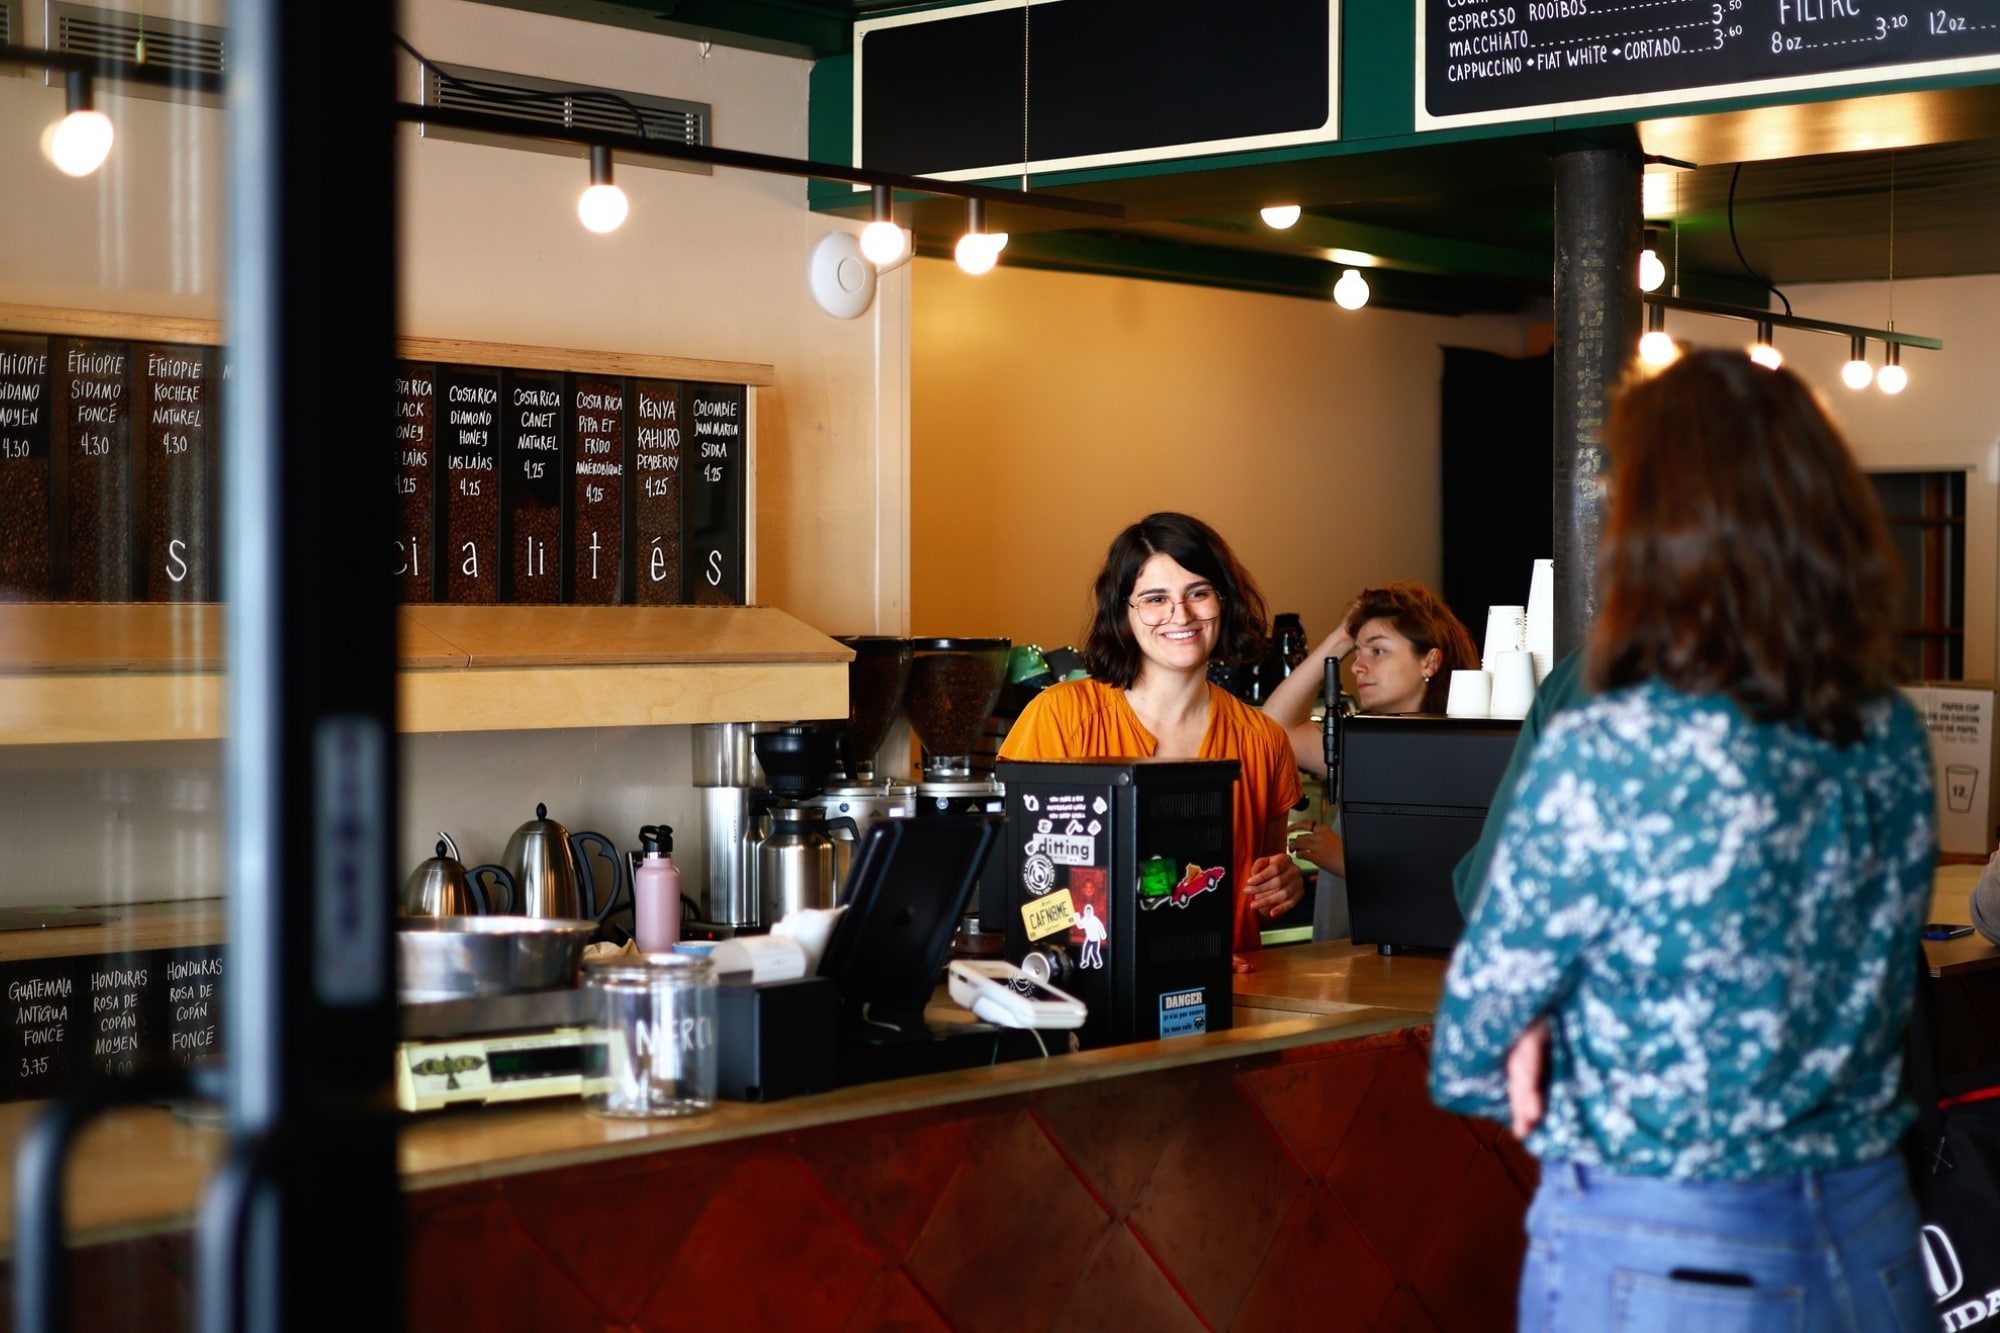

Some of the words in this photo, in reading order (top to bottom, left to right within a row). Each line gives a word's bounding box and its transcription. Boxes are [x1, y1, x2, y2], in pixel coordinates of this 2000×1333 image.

[1624, 36, 1681, 61] CORTADO
[154, 383, 200, 403] KOCHERE
[78, 403, 117, 423] FONCÉ
[640, 393, 676, 420] KENYA
[153, 407, 201, 427] NATUREL
[521, 412, 556, 428] CANET
[601, 419, 616, 432] ET
[3, 438, 30, 458] 4.30
[81, 432, 109, 455] 4.30
[163, 432, 188, 454] 4.30
[460, 430, 487, 447] HONEY
[518, 434, 558, 450] NATUREL
[638, 426, 680, 450] KAHURO
[448, 455, 463, 470] LAS
[524, 460, 546, 479] 4.25
[637, 454, 679, 471] PEABERRY
[704, 464, 723, 482] 4.25
[460, 478, 480, 496] 4.25
[586, 484, 604, 504] 4.25
[645, 476, 669, 498] 4.25
[167, 957, 223, 981] HONDURAS
[9, 977, 72, 1001] GUATEMALA
[91, 969, 148, 991] HONDURAS
[93, 996, 119, 1013] ROSA
[124, 993, 138, 1009] DE
[170, 986, 194, 1003] ROSA
[200, 983, 213, 998] DE
[1165, 991, 1203, 1009] DANGER
[101, 1010, 136, 1032] COPÁN
[176, 1001, 208, 1022] COPÁN
[24, 1023, 65, 1046] FONCÉ
[95, 1033, 138, 1055] MOYEN
[172, 1024, 215, 1050] FONCÉ
[20, 1056, 50, 1077] 3.75
